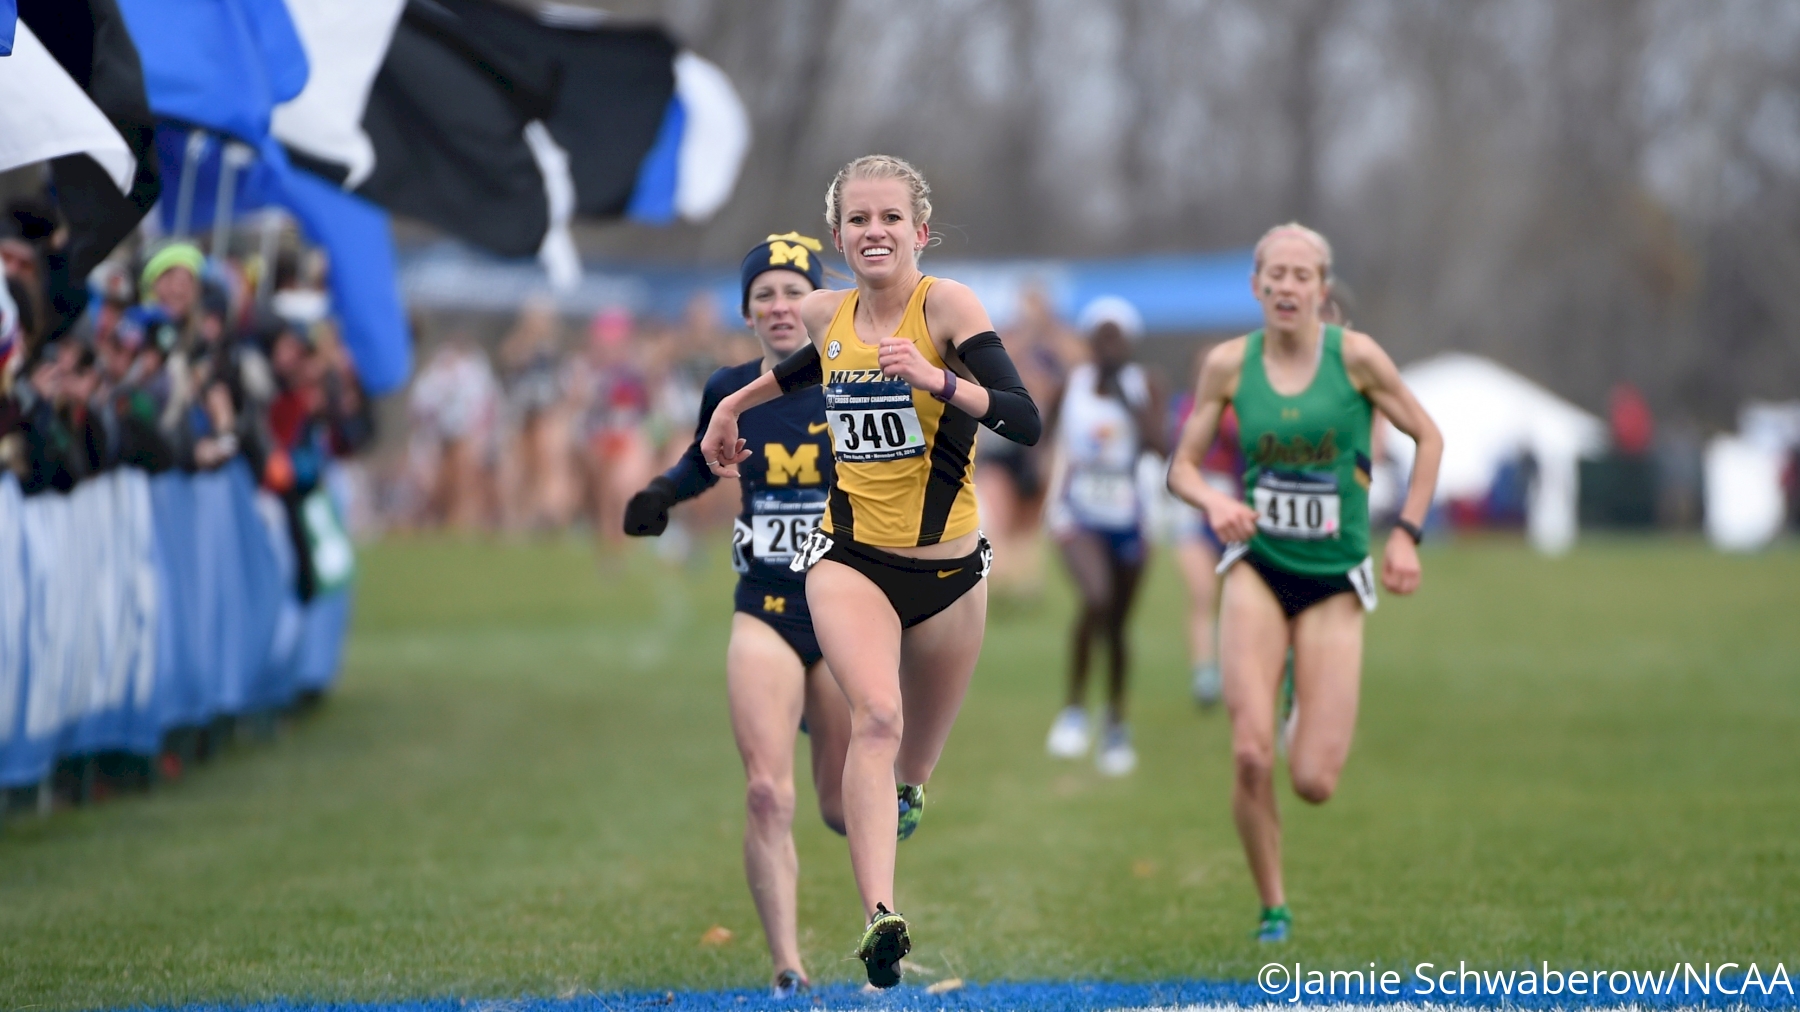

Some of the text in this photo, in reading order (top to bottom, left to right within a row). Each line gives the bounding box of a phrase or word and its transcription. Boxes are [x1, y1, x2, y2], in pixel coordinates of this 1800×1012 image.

[769, 241, 810, 271] M
[849, 396, 870, 404] COUNTRY
[870, 395, 910, 403] CHAMPIONSHIPS
[839, 412, 907, 451] 340
[764, 443, 822, 485] M
[1267, 497, 1323, 530] 410
[763, 595, 786, 614] M
